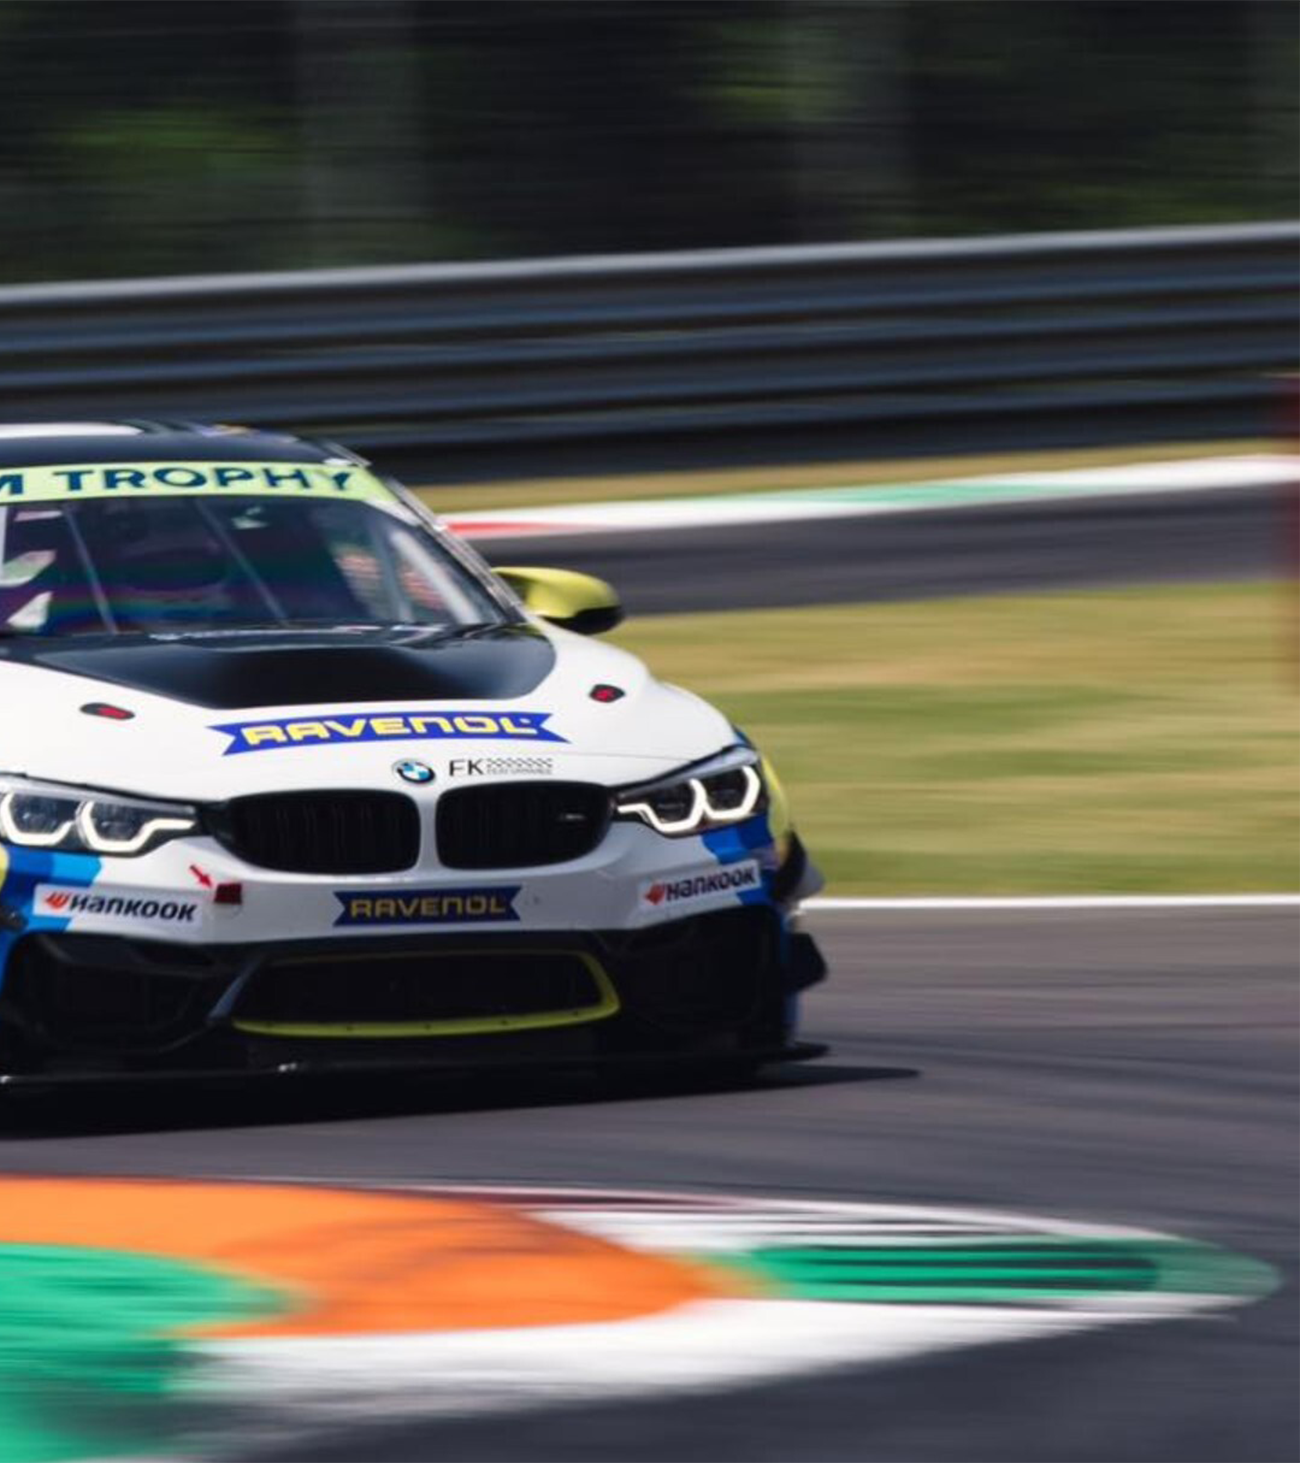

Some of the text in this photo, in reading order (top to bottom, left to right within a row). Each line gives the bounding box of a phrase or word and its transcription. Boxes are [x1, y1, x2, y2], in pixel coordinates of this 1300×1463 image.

[52, 466, 352, 491] TROPHY
[241, 714, 539, 746] RAVENOL
[449, 758, 484, 777] FK
[349, 893, 507, 919] RAVENOL
